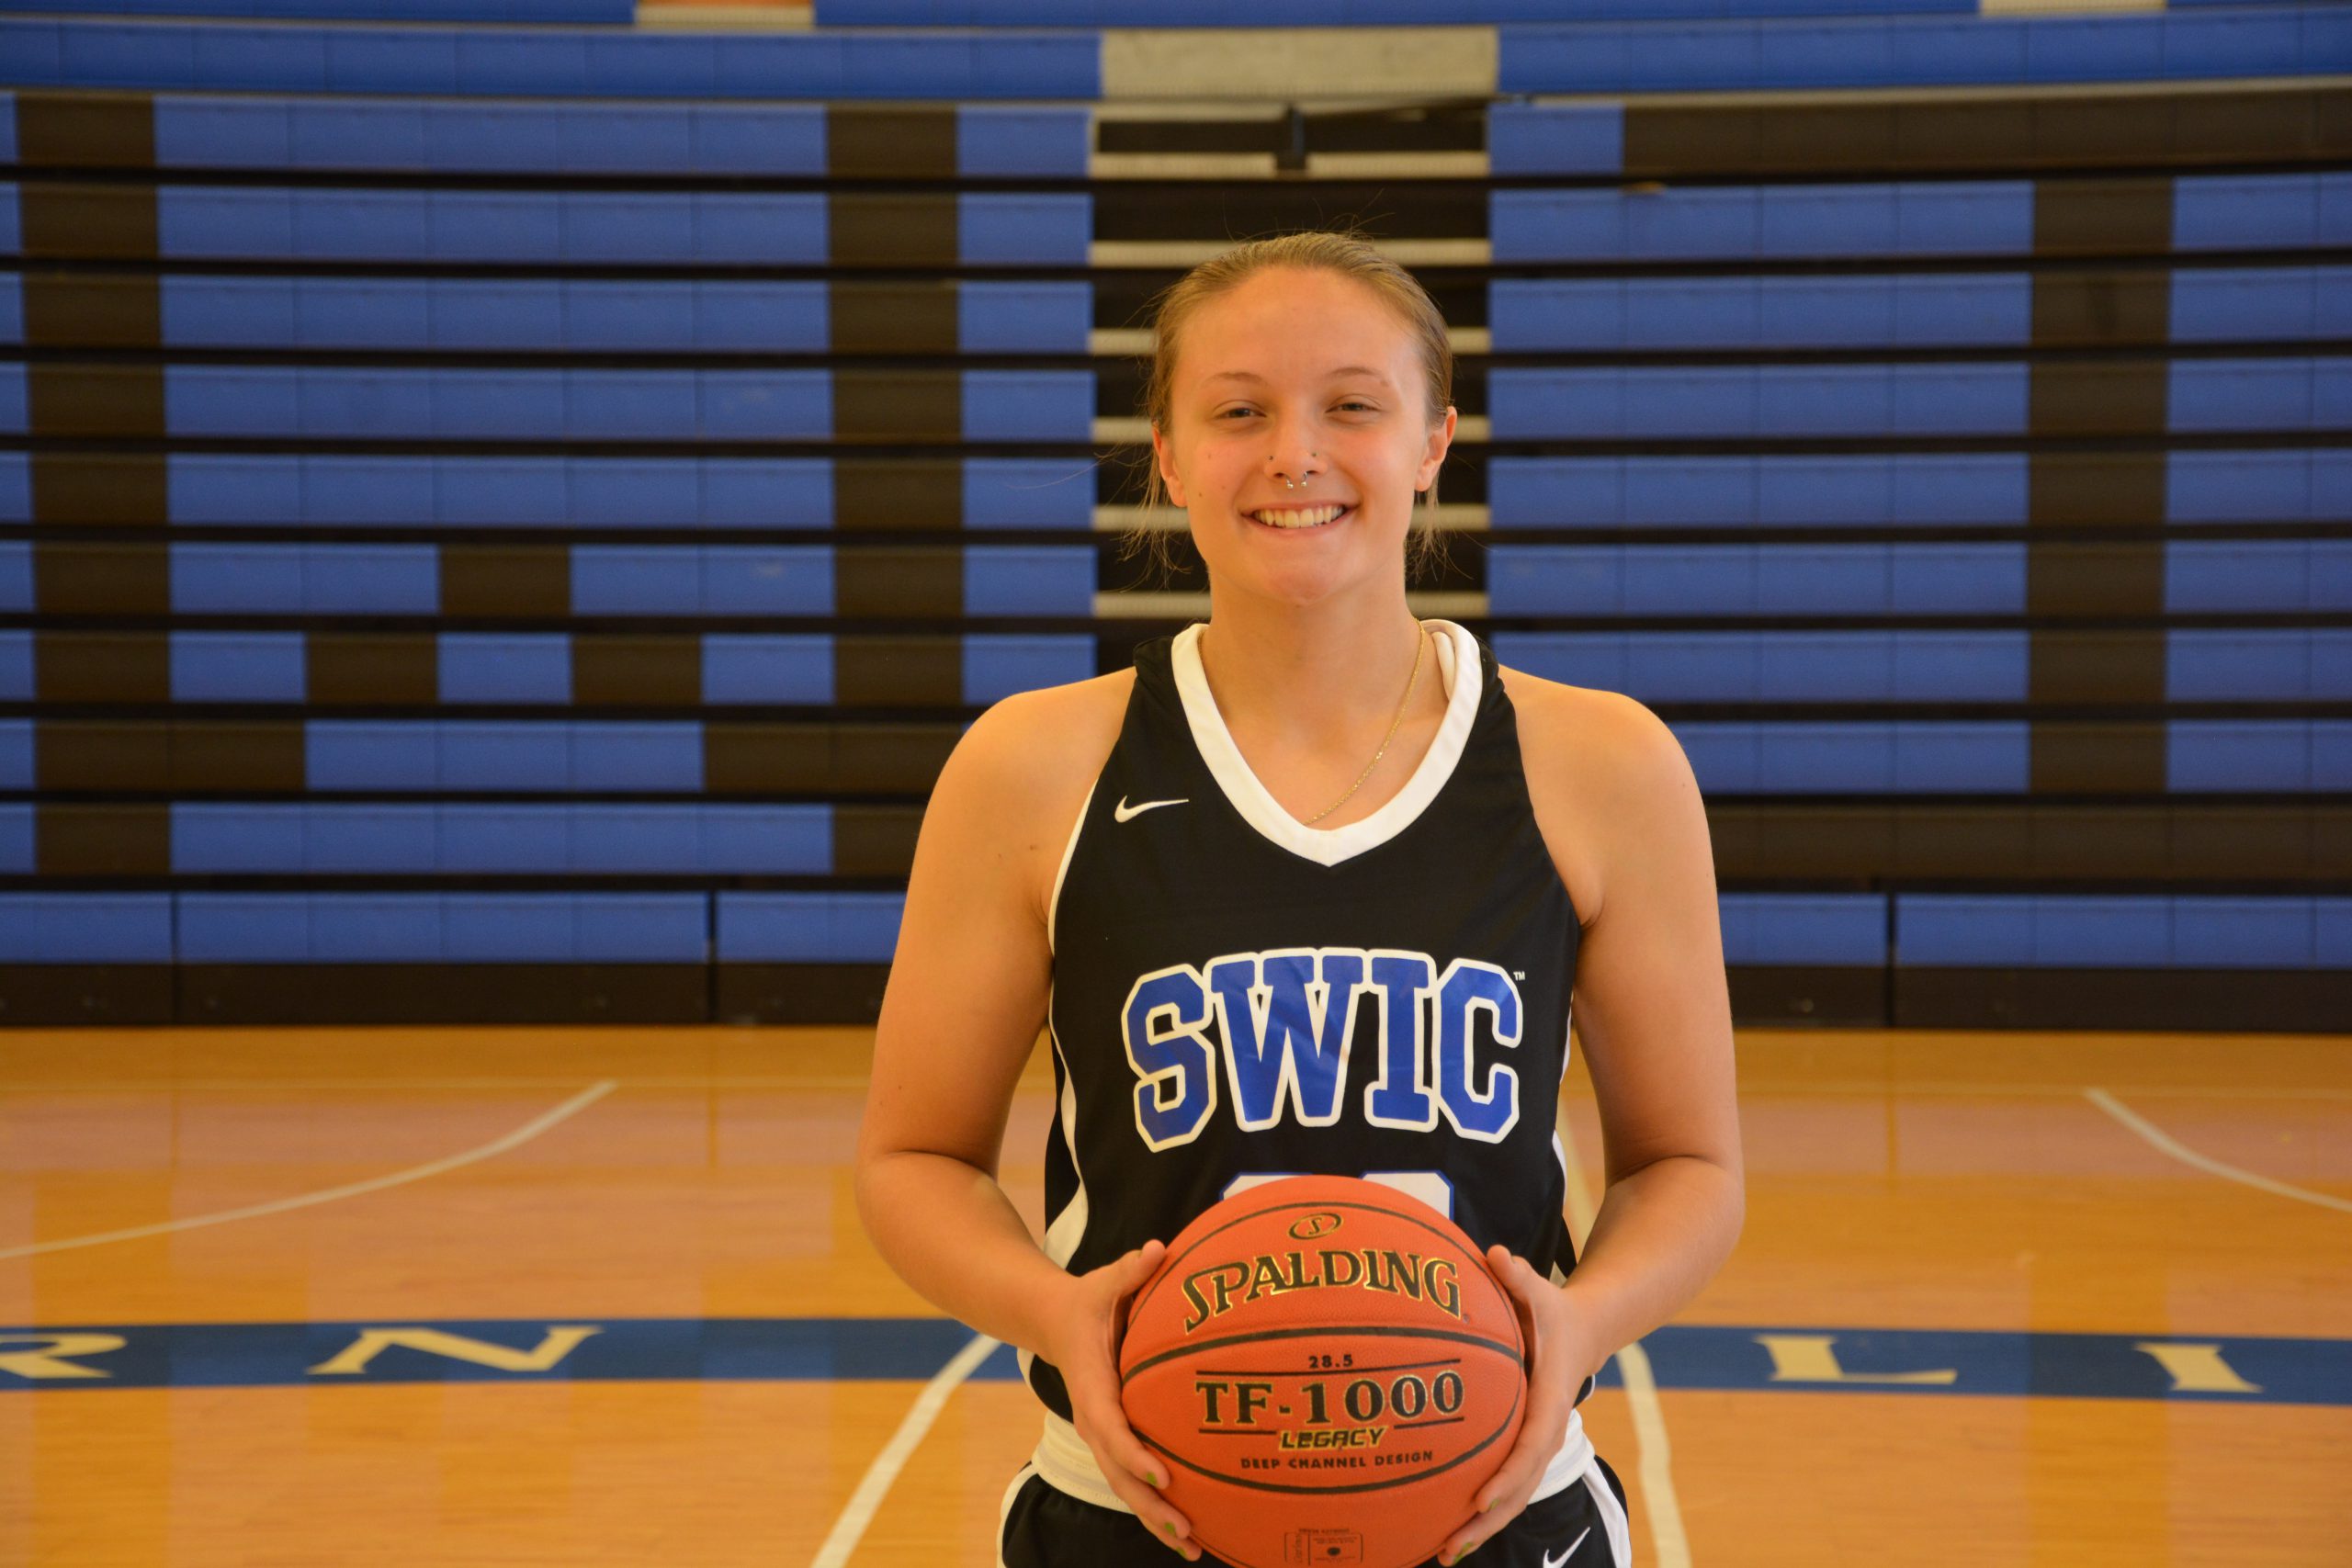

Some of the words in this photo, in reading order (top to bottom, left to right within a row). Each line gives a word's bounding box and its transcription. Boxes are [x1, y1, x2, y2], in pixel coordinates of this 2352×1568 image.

[1122, 947, 1522, 1152] SWIC
[1182, 1249, 1463, 1335] SPALDING
[1308, 1354, 1353, 1369] 28.5
[1195, 1370, 1464, 1425] TF-1000
[1279, 1426, 1386, 1451] LEGACY
[1240, 1458, 1280, 1470] DEEP
[1288, 1455, 1366, 1469] CHANNEL
[1374, 1450, 1433, 1467] DESIGN
